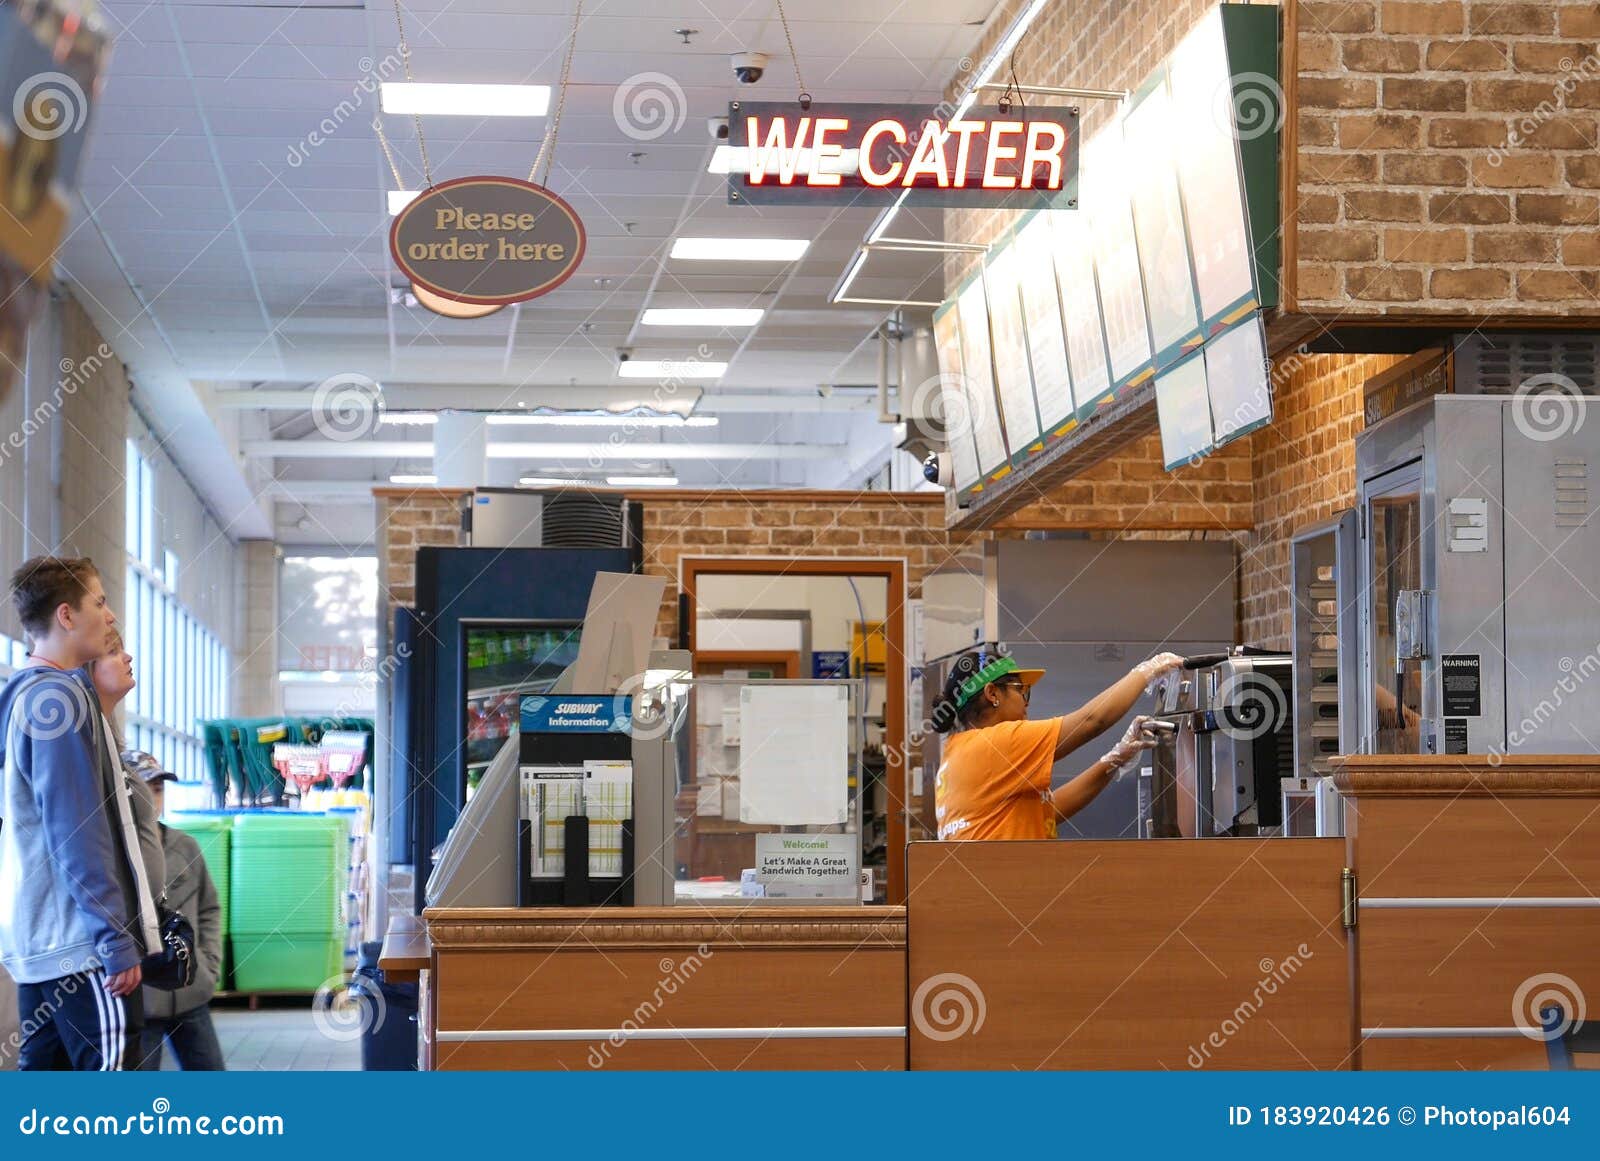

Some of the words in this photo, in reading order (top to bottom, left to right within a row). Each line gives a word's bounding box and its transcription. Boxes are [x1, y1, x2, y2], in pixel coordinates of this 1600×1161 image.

[746, 116, 849, 186] WE
[857, 118, 1067, 189] CATER
[435, 207, 536, 230] Please
[408, 237, 490, 261] order
[497, 237, 565, 261] here
[1443, 660, 1479, 668] WARNING
[554, 703, 603, 714] SUBWAY
[548, 717, 609, 727] Information
[783, 840, 829, 849] Welcome!
[764, 857, 785, 866] Let's
[787, 857, 811, 866] Make
[813, 857, 820, 866] A
[822, 857, 847, 866] Great
[761, 866, 804, 875] Sandwich
[807, 866, 849, 877] Together!
